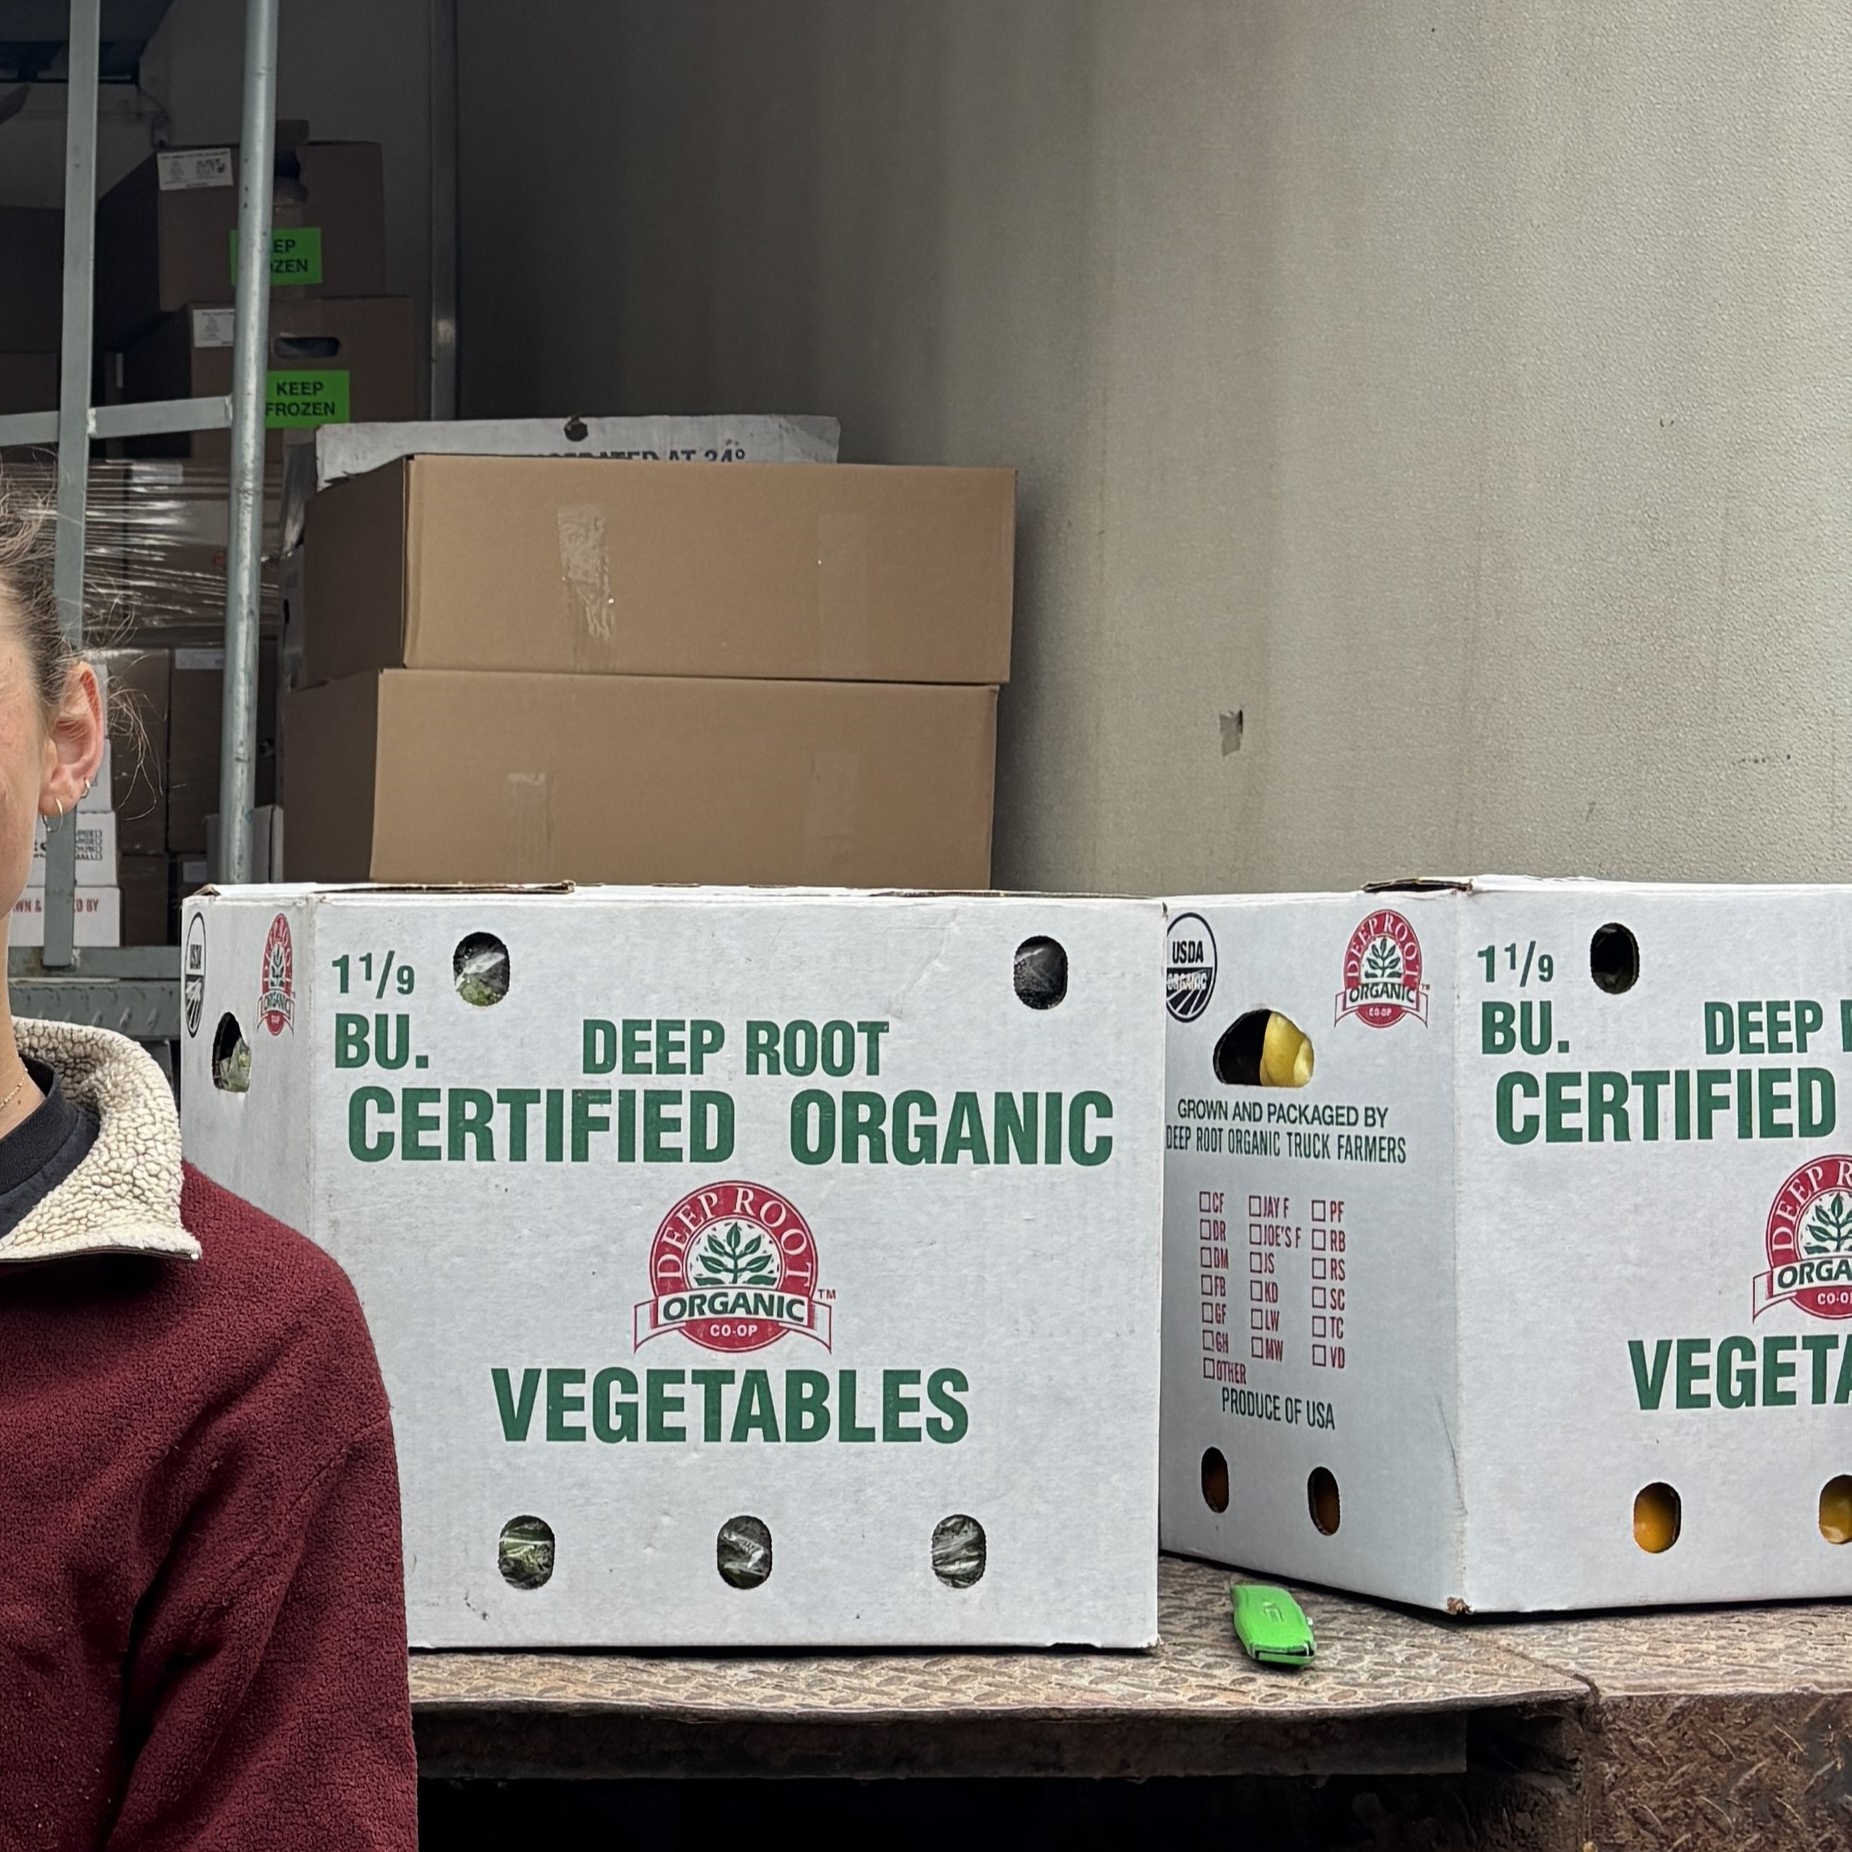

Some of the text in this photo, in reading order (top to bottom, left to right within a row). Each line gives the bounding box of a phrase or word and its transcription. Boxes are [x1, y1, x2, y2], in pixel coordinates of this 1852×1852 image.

[274, 239, 295, 252] EP
[276, 381, 324, 396] KEEP
[264, 402, 336, 417] FROZEN
[1172, 940, 1204, 964] USDA
[1346, 913, 1419, 982] DEEP ROOT
[1349, 982, 1415, 1004] ORGANIC
[1481, 1000, 1570, 1056] BU.
[1704, 1000, 1824, 1056] DEEP
[335, 1013, 429, 1069] BU.
[582, 1019, 890, 1076] DEEP ROOT
[1178, 1098, 1389, 1129] GROWN AND PACKAGED BY
[1496, 1067, 1837, 1146] CERTIFIED
[348, 1086, 1113, 1167] CERTIFIED ORGANIC
[1166, 1125, 1407, 1164] DEEP ROOT ORGANIC TRUCK FARMERS
[1212, 1192, 1224, 1214] CF
[1263, 1195, 1290, 1218] JAY F
[1330, 1200, 1345, 1223] PF
[1773, 1165, 1825, 1252] DEEP
[657, 1187, 812, 1287] DEEP ROOT
[1263, 1224, 1302, 1248] JOE'S F
[1330, 1229, 1346, 1252] RB
[1264, 1252, 1275, 1274] JS
[1330, 1258, 1346, 1281] RS
[1214, 1275, 1226, 1297] FB
[1265, 1281, 1279, 1303] KD
[663, 1291, 806, 1323] ORGANIC
[1330, 1288, 1346, 1310] SC
[709, 1324, 758, 1337] CO-OP
[1265, 1309, 1280, 1332] LW
[1329, 1316, 1344, 1340] TC
[1265, 1338, 1284, 1362] MW
[1330, 1346, 1346, 1369] VD
[1216, 1360, 1247, 1385] OTHER
[491, 1367, 970, 1444] VEGETABLES
[1222, 1386, 1336, 1430] PRODUCE OF USA
